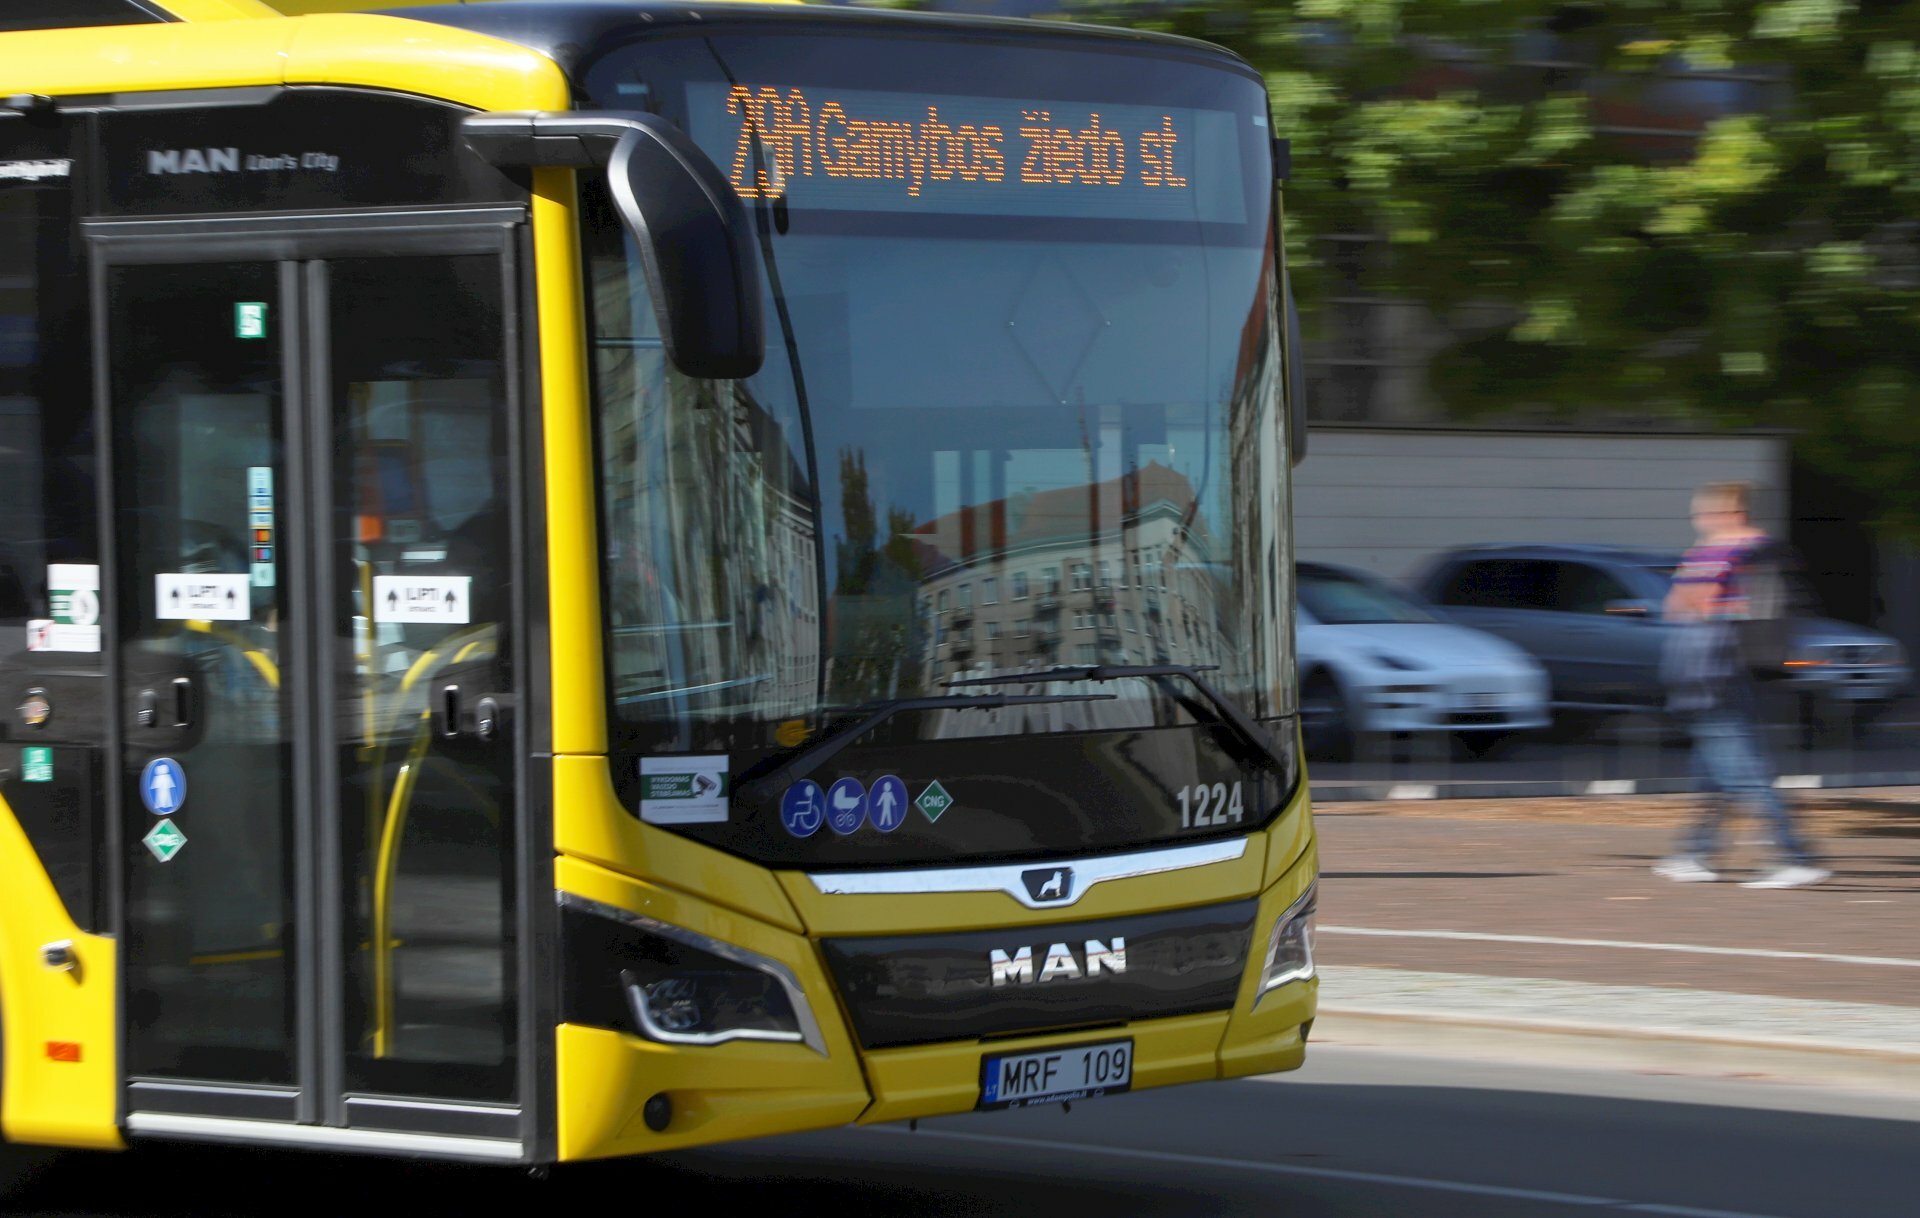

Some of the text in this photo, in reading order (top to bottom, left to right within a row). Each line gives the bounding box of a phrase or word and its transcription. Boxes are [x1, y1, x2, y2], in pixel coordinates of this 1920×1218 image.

[148, 147, 240, 175] MAN
[726, 85, 1187, 199] 29A Gamybos žiedo st.
[923, 795, 945, 808] CNG
[1177, 781, 1244, 828] 1224
[990, 936, 1127, 987] MAN
[985, 1084, 998, 1096] LT
[1001, 1047, 1127, 1096] MRF 109
